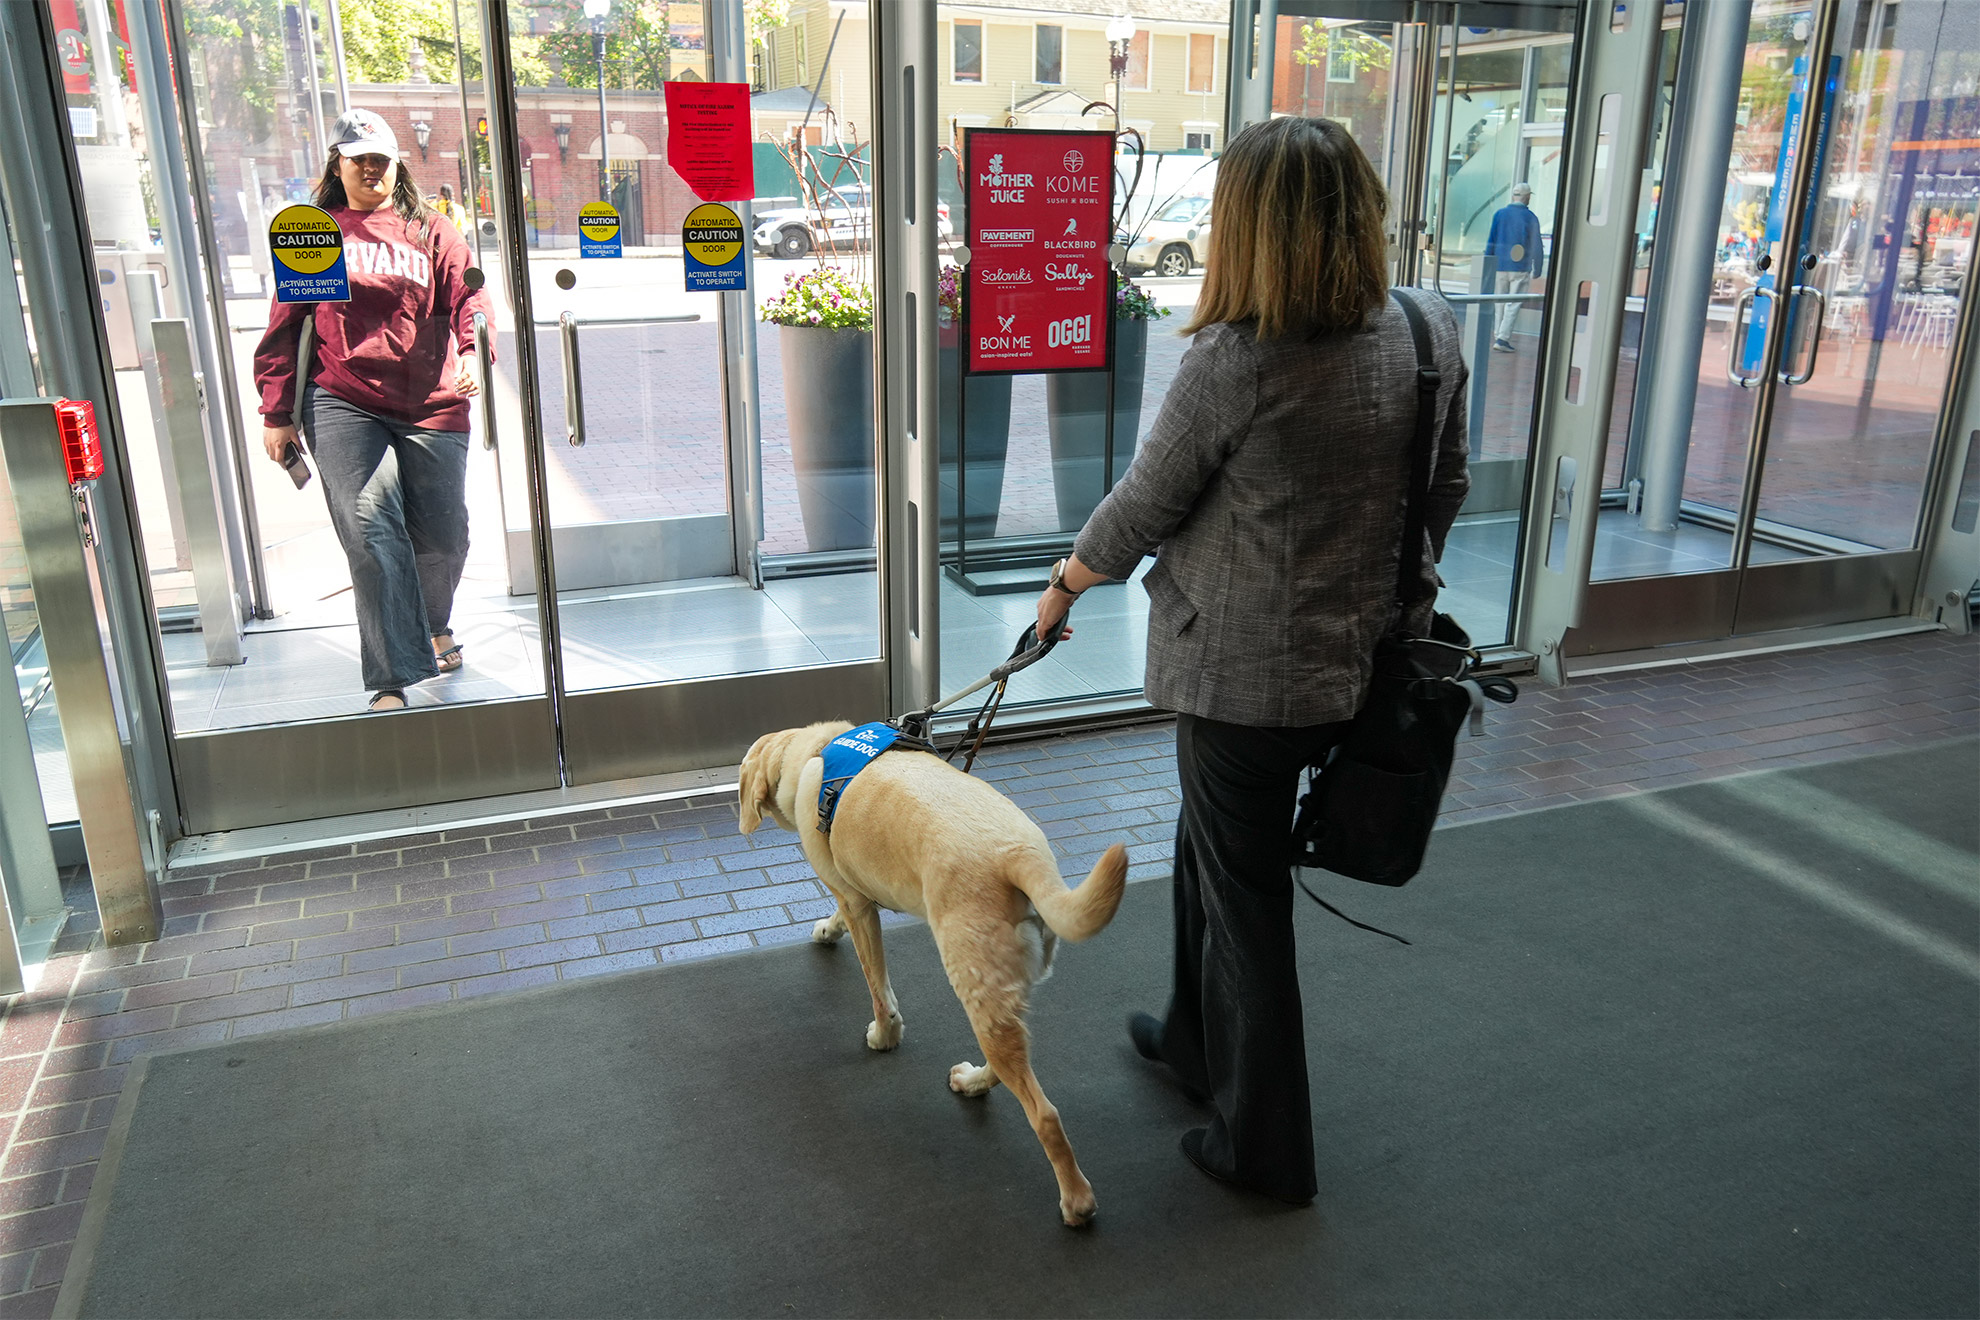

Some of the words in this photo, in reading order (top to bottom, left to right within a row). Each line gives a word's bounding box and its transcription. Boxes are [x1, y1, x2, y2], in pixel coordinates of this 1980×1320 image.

[1778, 113, 1800, 210] EMERGENCY
[980, 173, 1035, 187] MOTHER
[1046, 176, 1099, 193] KOME
[278, 222, 331, 231] AUTOMATIC
[690, 218, 735, 226] AUTOMATIC
[277, 234, 335, 246] CAUTION
[689, 230, 738, 240] CAUTION
[982, 232, 1032, 240] PAVEMENT
[1044, 241, 1096, 249] BLACKBIRD
[295, 250, 322, 259] DOOR
[344, 242, 429, 288] RVARD
[718, 270, 742, 278] SWITCH
[981, 268, 1032, 281] Saloniki
[1044, 262, 1094, 285] Sally's
[279, 280, 314, 288] ACTIVATE
[315, 279, 344, 287] SWITCH
[289, 288, 300, 296] TO
[301, 287, 336, 295] OPERATE
[1048, 314, 1092, 348] OGGI
[980, 336, 1010, 350] BON
[1012, 336, 1031, 349] ME
[833, 737, 861, 749] GUIDE
[855, 742, 879, 757] DOG
